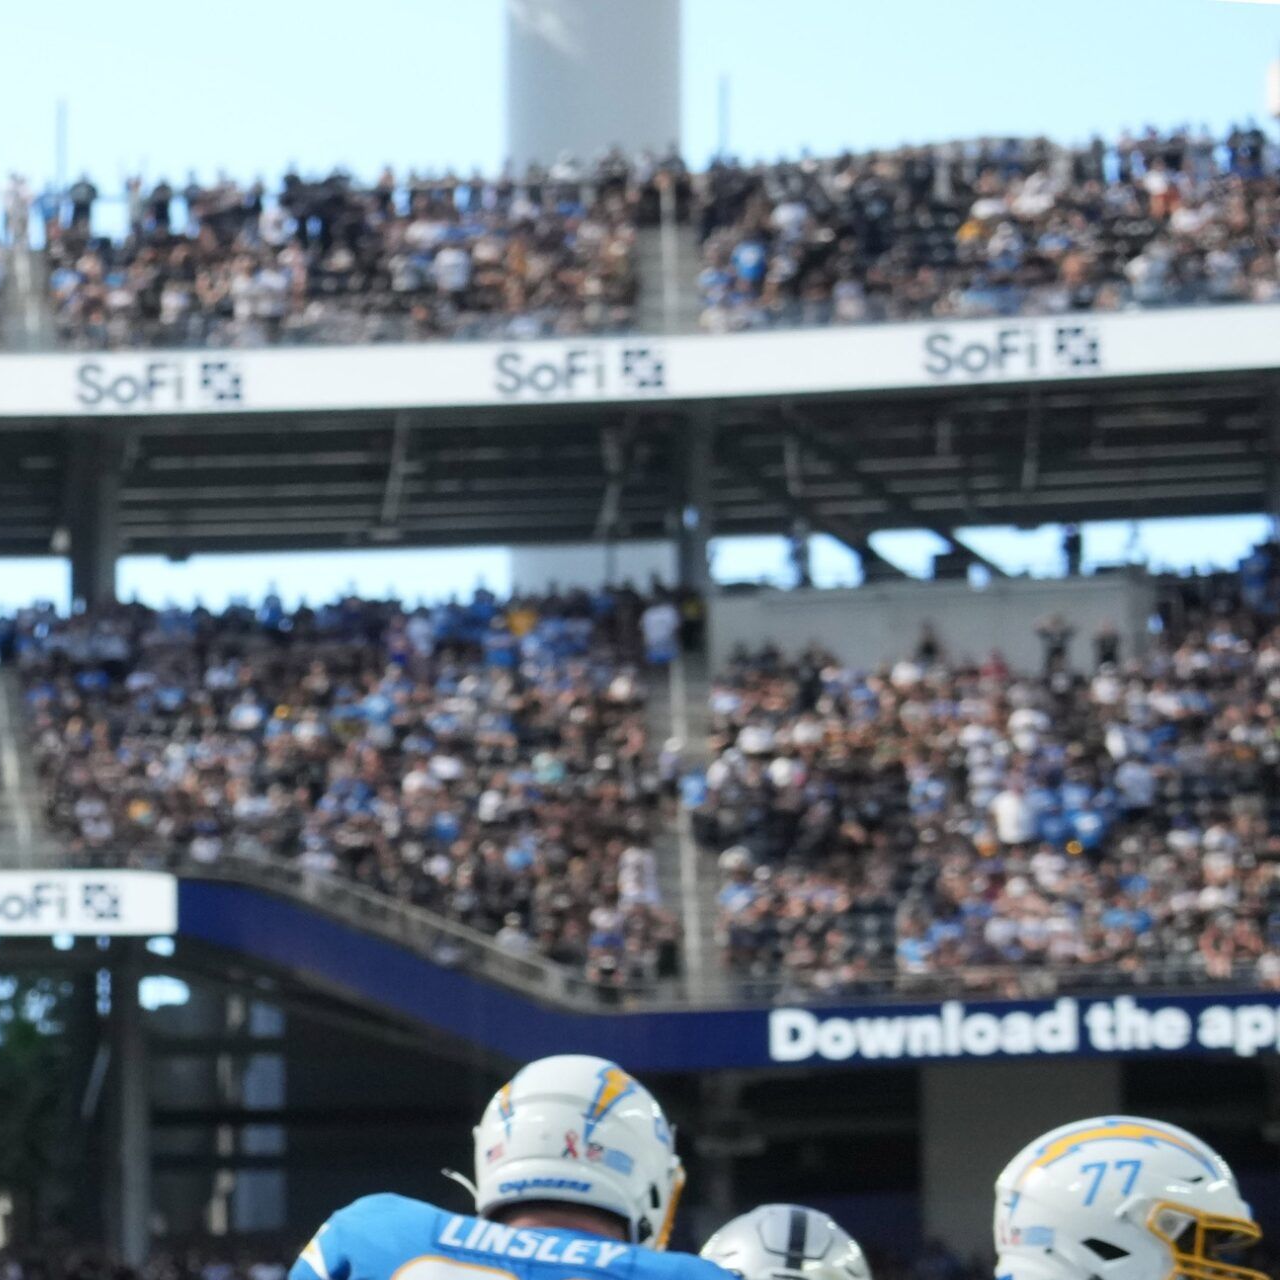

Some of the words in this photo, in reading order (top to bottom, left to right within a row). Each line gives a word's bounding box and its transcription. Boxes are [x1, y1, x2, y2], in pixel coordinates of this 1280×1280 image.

[495, 350, 606, 397] SoFi
[924, 328, 1037, 378] SoFi
[76, 361, 185, 406] SoFi
[767, 998, 1079, 1062] Download
[1084, 994, 1191, 1051] the
[1196, 1003, 1280, 1058] ap
[1080, 1159, 1143, 1207] 77
[438, 1215, 629, 1269] LINSLEY
